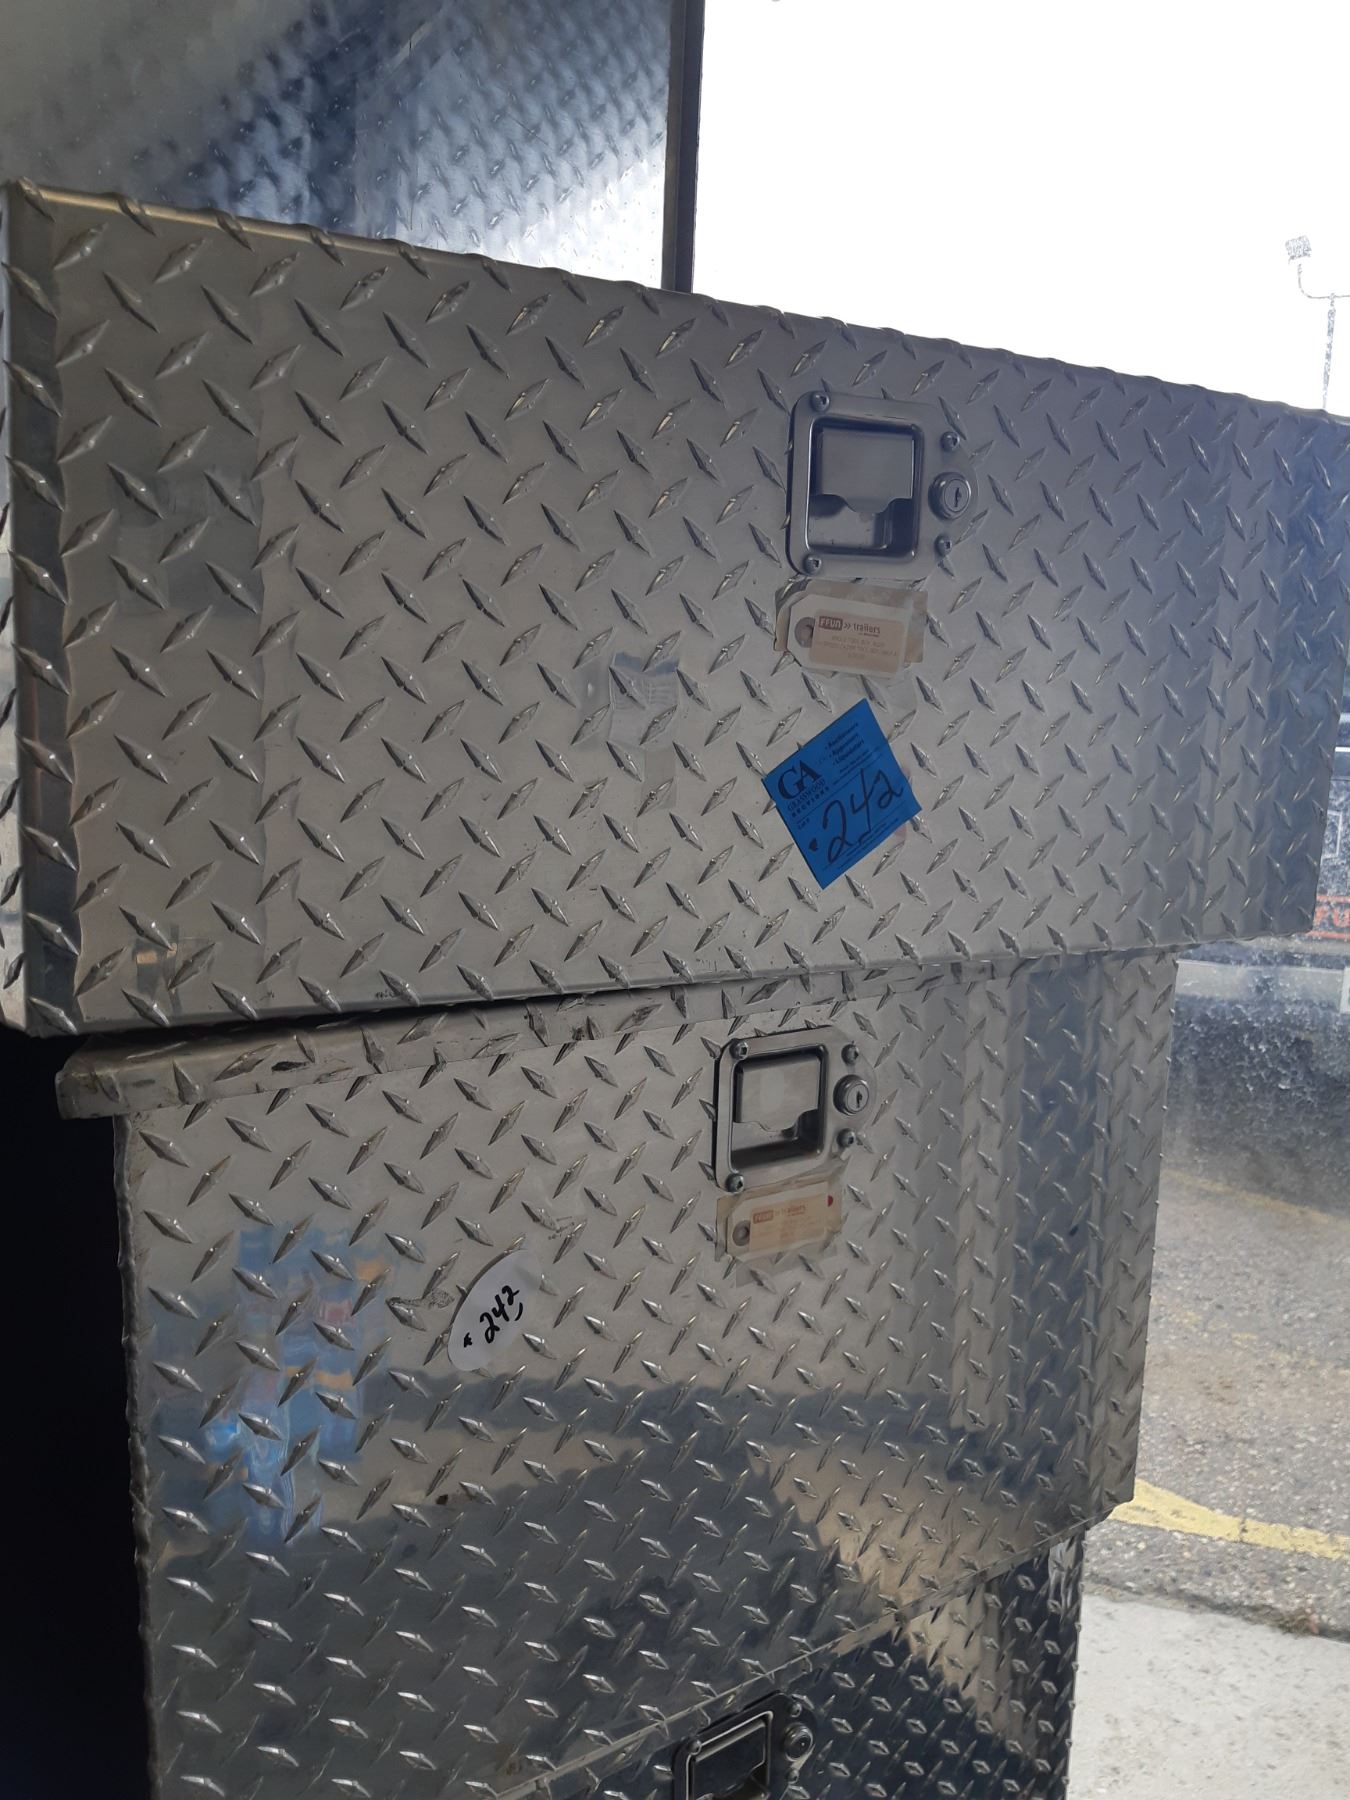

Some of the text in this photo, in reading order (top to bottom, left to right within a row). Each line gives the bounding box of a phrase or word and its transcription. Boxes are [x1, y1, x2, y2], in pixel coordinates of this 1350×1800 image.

[777, 760, 822, 800] GA
[822, 767, 904, 864] 242
[479, 1285, 520, 1344] 242
